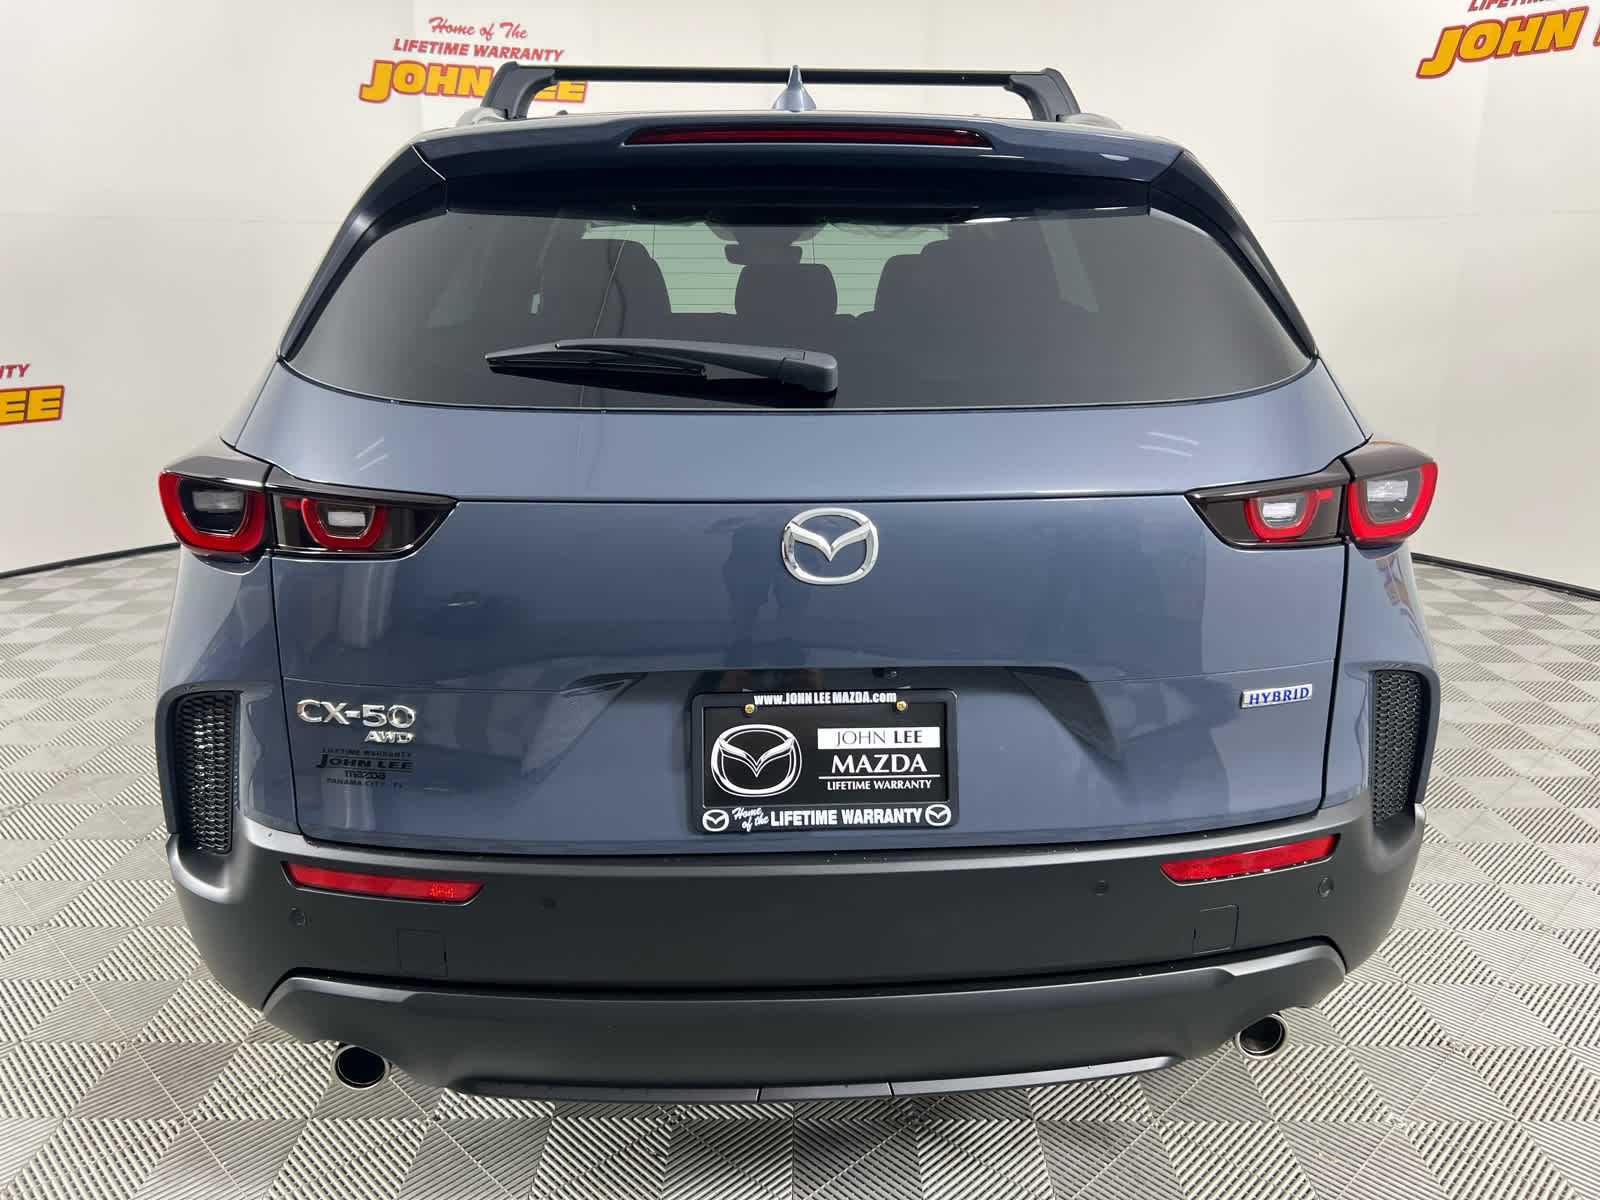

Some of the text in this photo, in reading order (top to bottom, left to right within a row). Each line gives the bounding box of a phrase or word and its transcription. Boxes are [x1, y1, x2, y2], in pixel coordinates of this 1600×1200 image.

[428, 16, 528, 41] Home of The
[393, 38, 564, 62] LIFETIME WARRANTY
[1416, 6, 1589, 79] JOHN
[359, 60, 494, 103] JOHN
[0, 385, 65, 426] EE
[813, 692, 831, 704] LEE
[832, 691, 897, 704] MAZDA.com
[1248, 687, 1309, 704] HYBRID
[296, 698, 416, 728] CX-50
[364, 730, 414, 743] AWD
[837, 730, 923, 747] JOHN LEE
[316, 754, 414, 769] JOHN LEE
[831, 753, 928, 774] MAZDA
[827, 779, 932, 791] LIFETIME WARRANTY
[732, 807, 762, 820] Home
[741, 812, 770, 832] of the
[770, 807, 922, 827] LIFETIME WARRANTY
